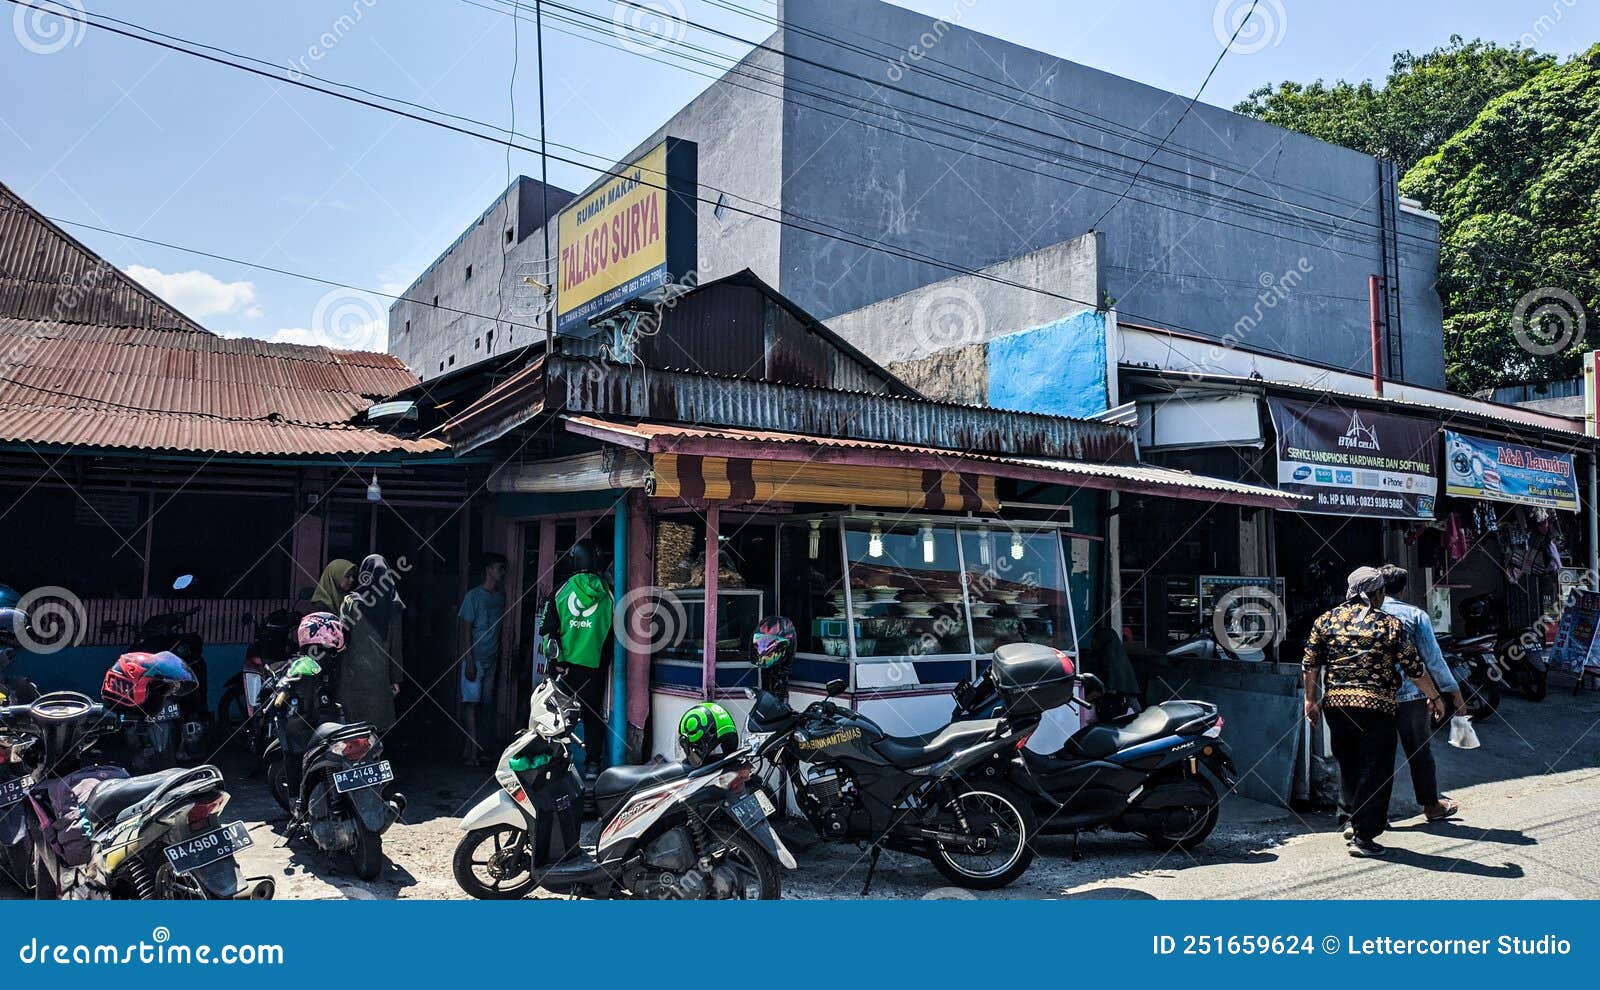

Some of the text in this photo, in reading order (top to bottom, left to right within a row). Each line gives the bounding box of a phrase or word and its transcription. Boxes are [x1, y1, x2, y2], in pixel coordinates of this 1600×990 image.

[577, 169, 641, 226] RUMAH MAKAN
[562, 191, 660, 292] TALAGO SURYA
[1287, 447, 1311, 461] SERVICE
[1311, 451, 1349, 464] HANDPHONE
[1349, 455, 1385, 468] HARDWARE
[1385, 459, 1399, 470] DAN
[1497, 446, 1570, 478] A&A Laundry
[1387, 476, 1404, 487] iPhone
[1318, 493, 1329, 505] No.
[1329, 494, 1339, 505] HP
[1340, 494, 1346, 505] &
[1359, 496, 1375, 507] 0823
[569, 620, 592, 629] gojek
[336, 773, 348, 783] BA
[353, 767, 374, 779] 4148
[168, 846, 188, 861] BA
[188, 834, 219, 854] 4960
